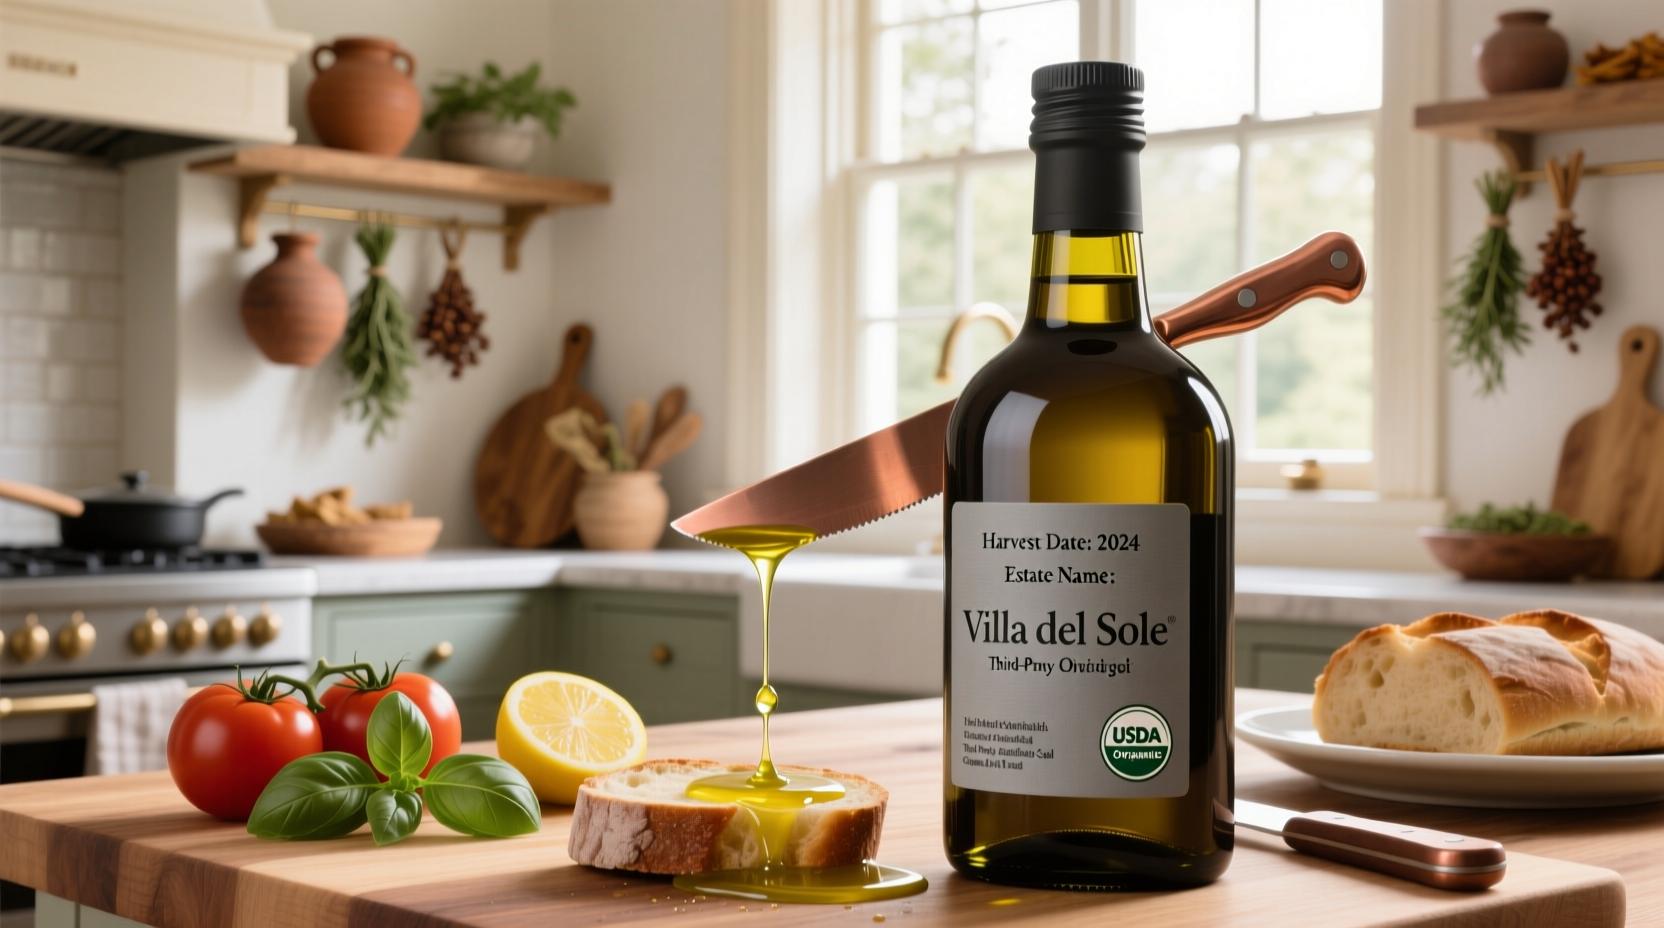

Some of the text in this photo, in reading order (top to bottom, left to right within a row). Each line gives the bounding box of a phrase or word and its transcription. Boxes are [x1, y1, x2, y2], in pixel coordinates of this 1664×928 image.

[982, 532, 1141, 552] Harvest Date: 2024
[1004, 566, 1115, 584] Estate Name:
[962, 609, 1028, 645] Villa
[1036, 610, 1086, 646] del
[1113, 726, 1162, 744] USDA
